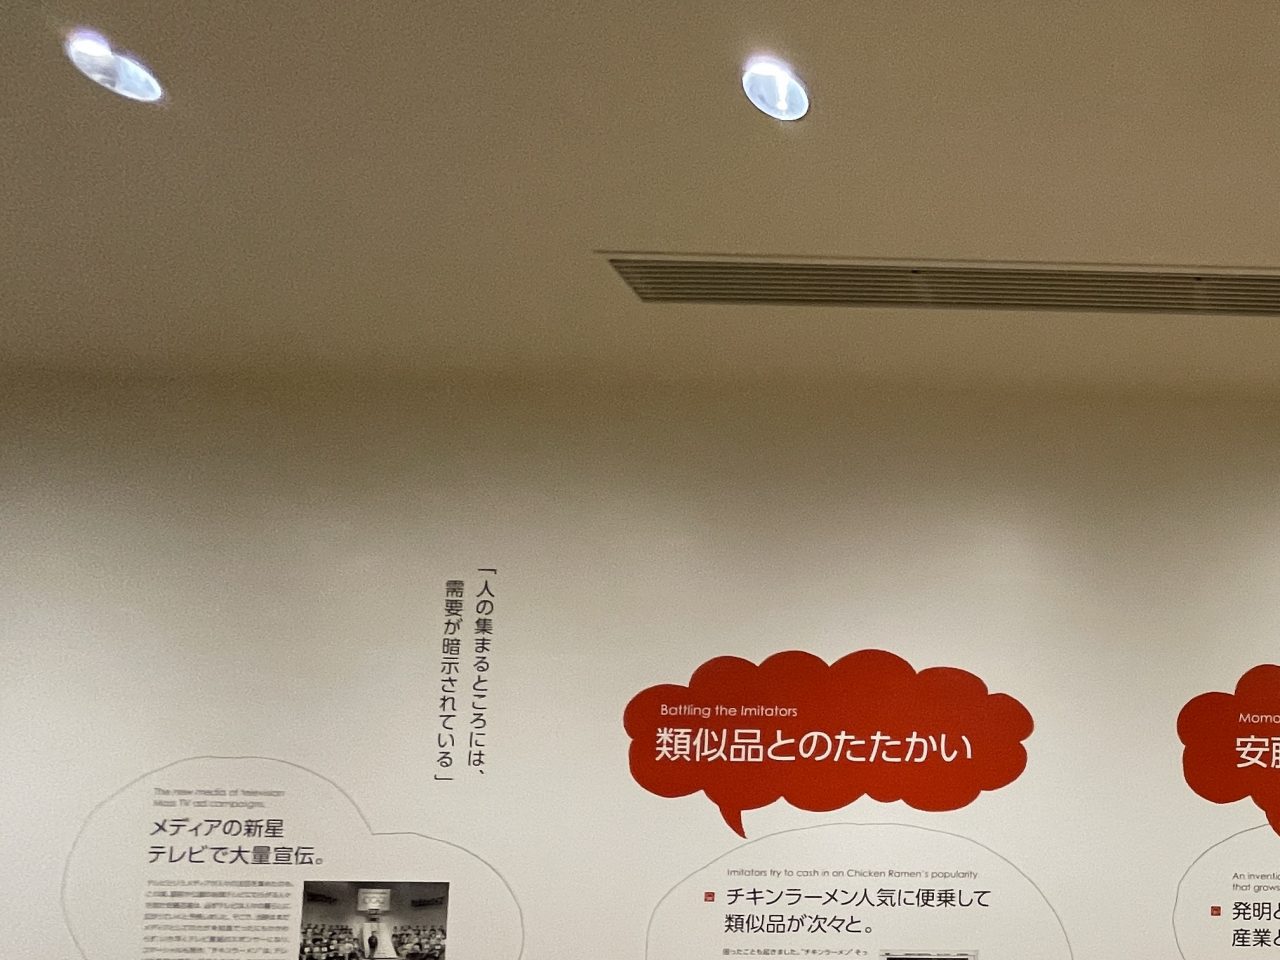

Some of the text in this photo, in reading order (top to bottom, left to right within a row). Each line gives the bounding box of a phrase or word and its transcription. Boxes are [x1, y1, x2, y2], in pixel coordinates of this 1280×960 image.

[433, 579, 465, 782] 需要が暗示されている」
[467, 566, 497, 776] 「人の集まるところには、
[660, 704, 798, 718] Battling the Imitators
[656, 727, 971, 762] 類似品とのたたかい
[150, 818, 284, 838] メディアの新星
[148, 845, 322, 865] テレビで大量宣伝。
[769, 869, 782, 879] try
[796, 869, 819, 877] cash
[821, 869, 830, 877] in
[846, 869, 886, 878] Chicken
[931, 870, 978, 879] popularity
[727, 888, 991, 907] チキンラーメン人気に便乗して
[1253, 885, 1280, 893] grows
[725, 914, 872, 933] 類似品が次々と。
